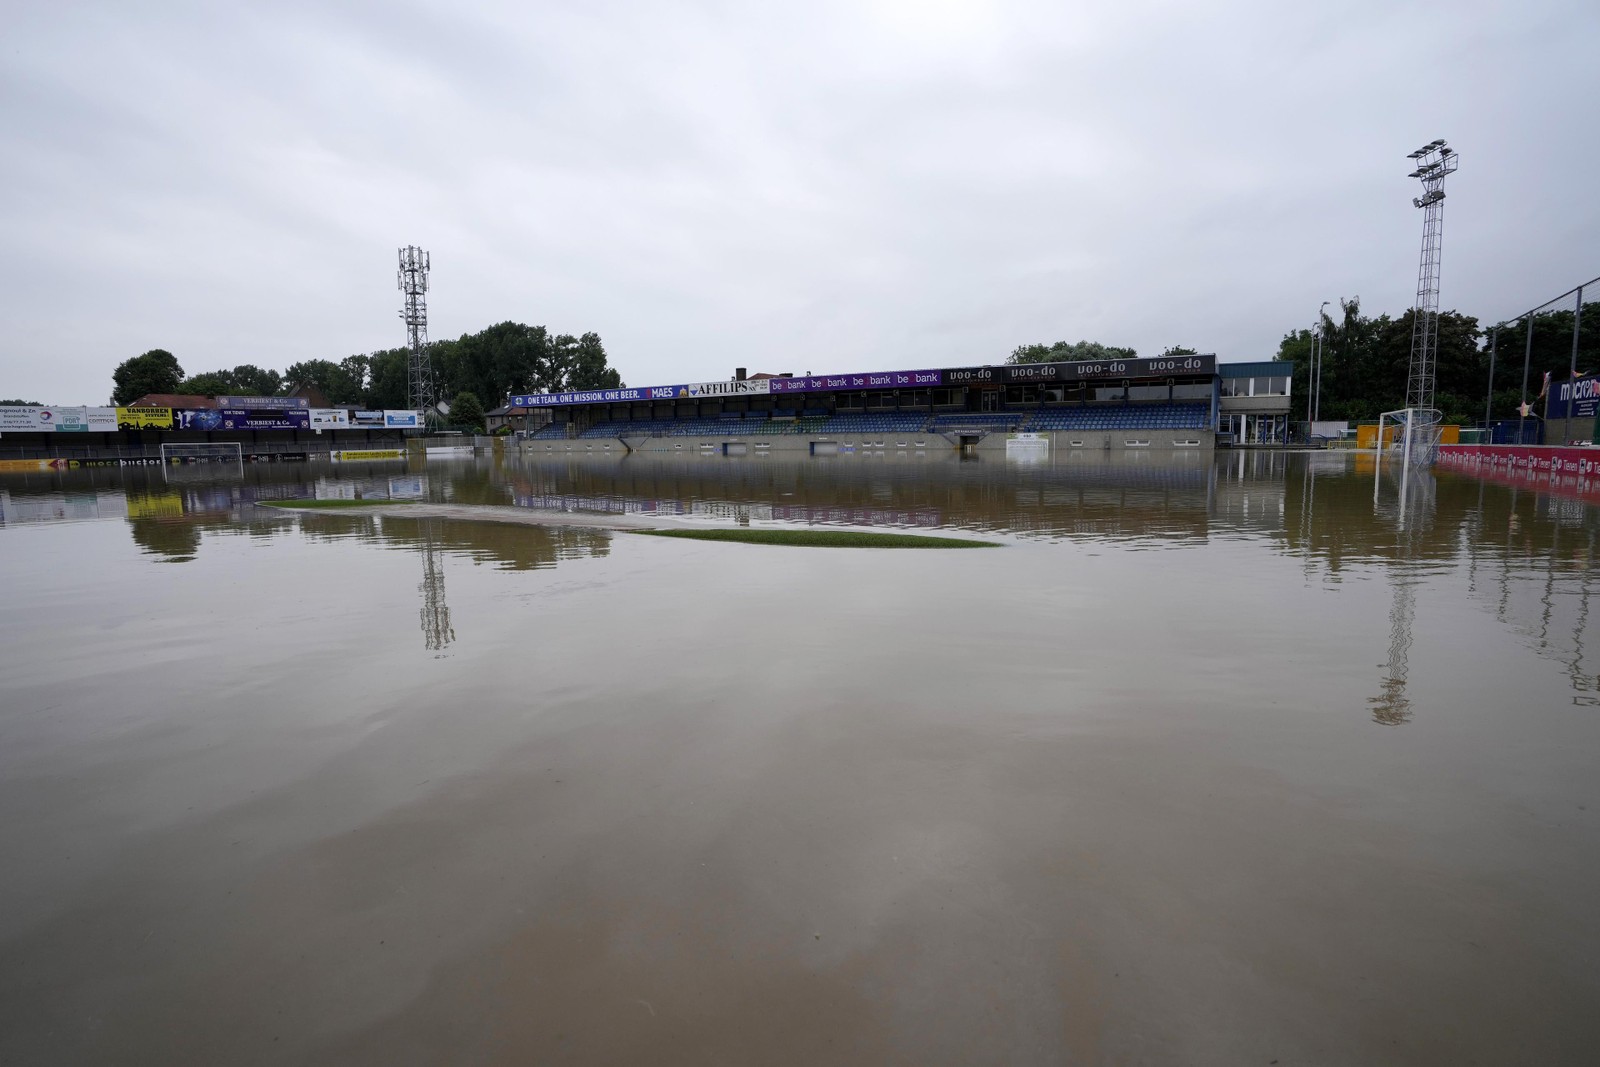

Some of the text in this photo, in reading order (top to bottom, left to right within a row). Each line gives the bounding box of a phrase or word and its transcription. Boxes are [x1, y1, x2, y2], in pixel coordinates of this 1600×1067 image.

[811, 378, 847, 388] be bank
[853, 376, 891, 386] be bank
[897, 373, 938, 384] be bank
[698, 382, 748, 395] AFFILIPS
[772, 382, 782, 390] be
[787, 381, 806, 389] bank
[527, 390, 640, 405] ONE TEAM. ONE MISSION. ONE BEER.
[651, 387, 673, 398] MAES
[1538, 458, 1551, 468] Tienen
[1563, 460, 1578, 471] Tienen
